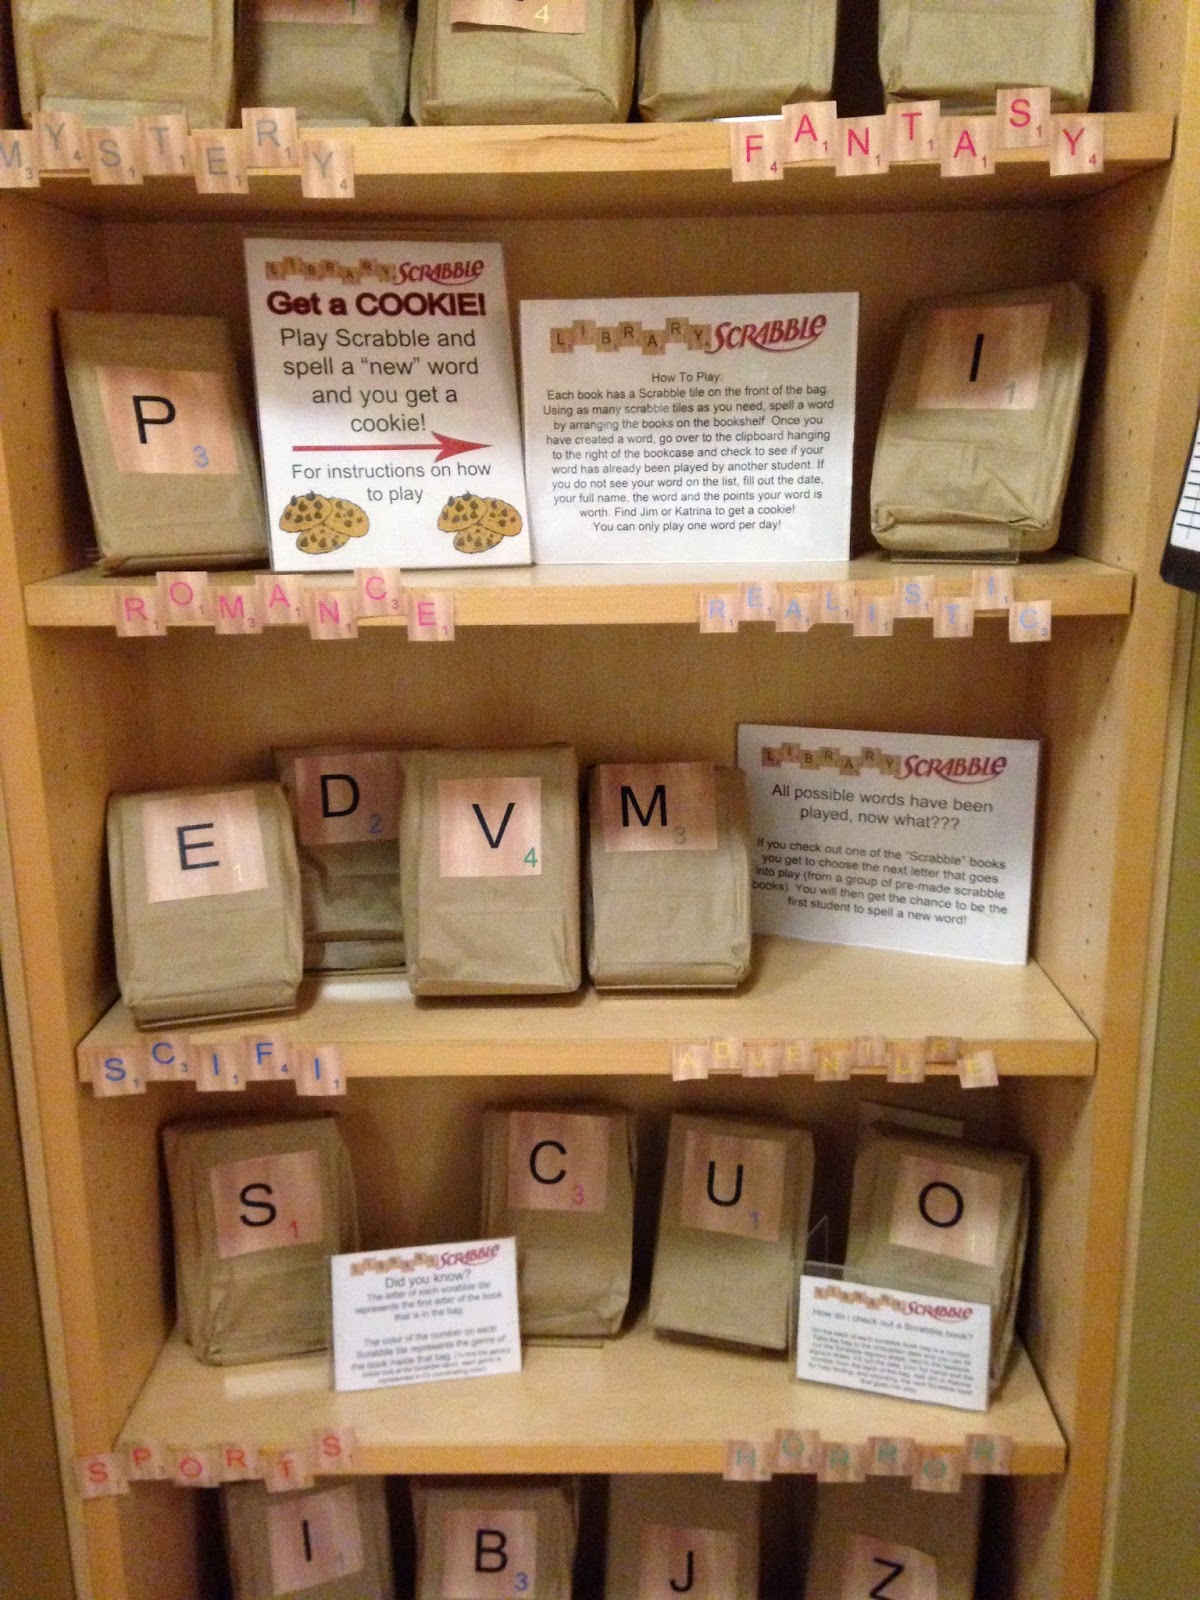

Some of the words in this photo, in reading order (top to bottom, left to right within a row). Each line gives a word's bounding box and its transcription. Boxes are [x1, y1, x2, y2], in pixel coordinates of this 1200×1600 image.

[534, 4, 549, 24] 4
[745, 98, 1087, 164] FANTASY
[0, 118, 338, 181] MYSTERY
[393, 259, 485, 286] SCRABBLE
[267, 292, 321, 315] Get
[329, 298, 347, 315] a
[355, 292, 485, 316] COOKIE!
[280, 329, 327, 350] Play
[336, 329, 429, 347] Scrabble
[437, 328, 475, 346] and
[553, 319, 707, 350] LIBRARY
[704, 313, 828, 354] SCRABBLE
[283, 357, 333, 379] spell
[341, 362, 353, 375] a
[361, 357, 419, 375] “new”
[427, 357, 478, 375] word
[969, 333, 984, 382] I
[651, 373, 675, 383] How
[680, 372, 692, 382] To
[696, 372, 721, 384] Play:
[312, 386, 351, 404] and
[359, 390, 397, 407] you
[405, 385, 438, 407] get
[445, 389, 457, 402] a
[547, 389, 573, 400] Each
[577, 389, 602, 399] book
[606, 388, 625, 398] has
[639, 387, 685, 398] Scrabble
[689, 387, 704, 397] tile
[707, 389, 720, 397] on
[725, 386, 741, 396] the
[744, 386, 768, 396] front
[772, 386, 782, 395] of
[786, 385, 802, 395] the
[806, 385, 829, 397] bag.
[132, 395, 176, 444] P
[350, 413, 424, 433] cookie!
[553, 420, 565, 432] by
[569, 419, 618, 432] arranging
[622, 418, 638, 428] the
[641, 418, 673, 428] books
[693, 417, 709, 427] the
[771, 415, 799, 426] Once
[803, 417, 822, 427] you
[546, 435, 571, 445] have
[574, 434, 613, 444] created
[617, 436, 623, 444] a
[659, 435, 672, 445] go
[675, 435, 698, 443] over
[702, 432, 712, 442] to
[715, 432, 731, 442] the
[735, 431, 783, 444] clipboard
[787, 430, 830, 443] hanging
[192, 444, 209, 468] 3
[552, 464, 576, 474] word
[580, 463, 599, 473] has
[602, 462, 640, 475] already
[644, 462, 669, 472] been
[673, 461, 708, 474] played
[711, 461, 724, 473] by
[727, 460, 767, 471] another
[817, 459, 824, 469] If
[292, 463, 321, 479] For
[327, 461, 424, 479] instructions
[430, 464, 450, 477] on
[457, 460, 490, 476] how
[366, 487, 382, 501] to
[389, 486, 423, 504] play
[614, 506, 636, 516] Find
[640, 506, 657, 516] Jim
[661, 508, 671, 516] or
[675, 505, 711, 515] Katrina
[715, 505, 724, 515] to
[728, 505, 744, 517] get
[757, 504, 794, 514] cookie!
[593, 521, 613, 531] You
[616, 523, 635, 531] can
[638, 520, 659, 533] only
[662, 520, 684, 532] play
[687, 522, 706, 530] one
[710, 519, 735, 529] word
[738, 521, 755, 531] per
[758, 518, 780, 531] day!
[124, 576, 438, 627] ROMANCE
[709, 575, 1039, 631] REALISTIC
[764, 746, 897, 772] LIBRARY
[896, 754, 1008, 785] SCRABBLE
[320, 773, 360, 818] D
[620, 784, 669, 828] M
[771, 785, 789, 796] All
[794, 787, 854, 803] possible
[859, 792, 904, 804] words
[910, 796, 947, 808] have
[952, 799, 993, 811] been
[368, 814, 383, 833] 2
[472, 802, 516, 849] V
[858, 814, 888, 823] now
[893, 815, 959, 828] what???
[175, 821, 220, 871] E
[674, 826, 687, 845] 3
[523, 848, 538, 868] 4
[761, 855, 781, 865] you
[784, 855, 801, 866] get
[804, 857, 815, 865] to
[817, 858, 858, 869] choose
[861, 862, 879, 871] the
[882, 864, 907, 873] next
[910, 867, 939, 876] letter
[942, 869, 965, 879] that
[968, 874, 998, 884] goes
[788, 897, 807, 906] first
[810, 900, 850, 911] student
[853, 904, 864, 913] to
[866, 906, 893, 918] spell
[907, 912, 931, 920] new
[934, 913, 966, 923] word!
[528, 1140, 567, 1184] C
[572, 1184, 585, 1205] 3
[707, 1160, 744, 1207] U
[239, 1183, 278, 1227] S
[919, 1181, 964, 1228] O
[288, 1220, 299, 1239] 1
[88, 1434, 342, 1484] SPORTS
[475, 1528, 508, 1573] B
[515, 1572, 529, 1592] 3
[669, 1550, 693, 1593] J
[869, 1557, 905, 1600] Z
